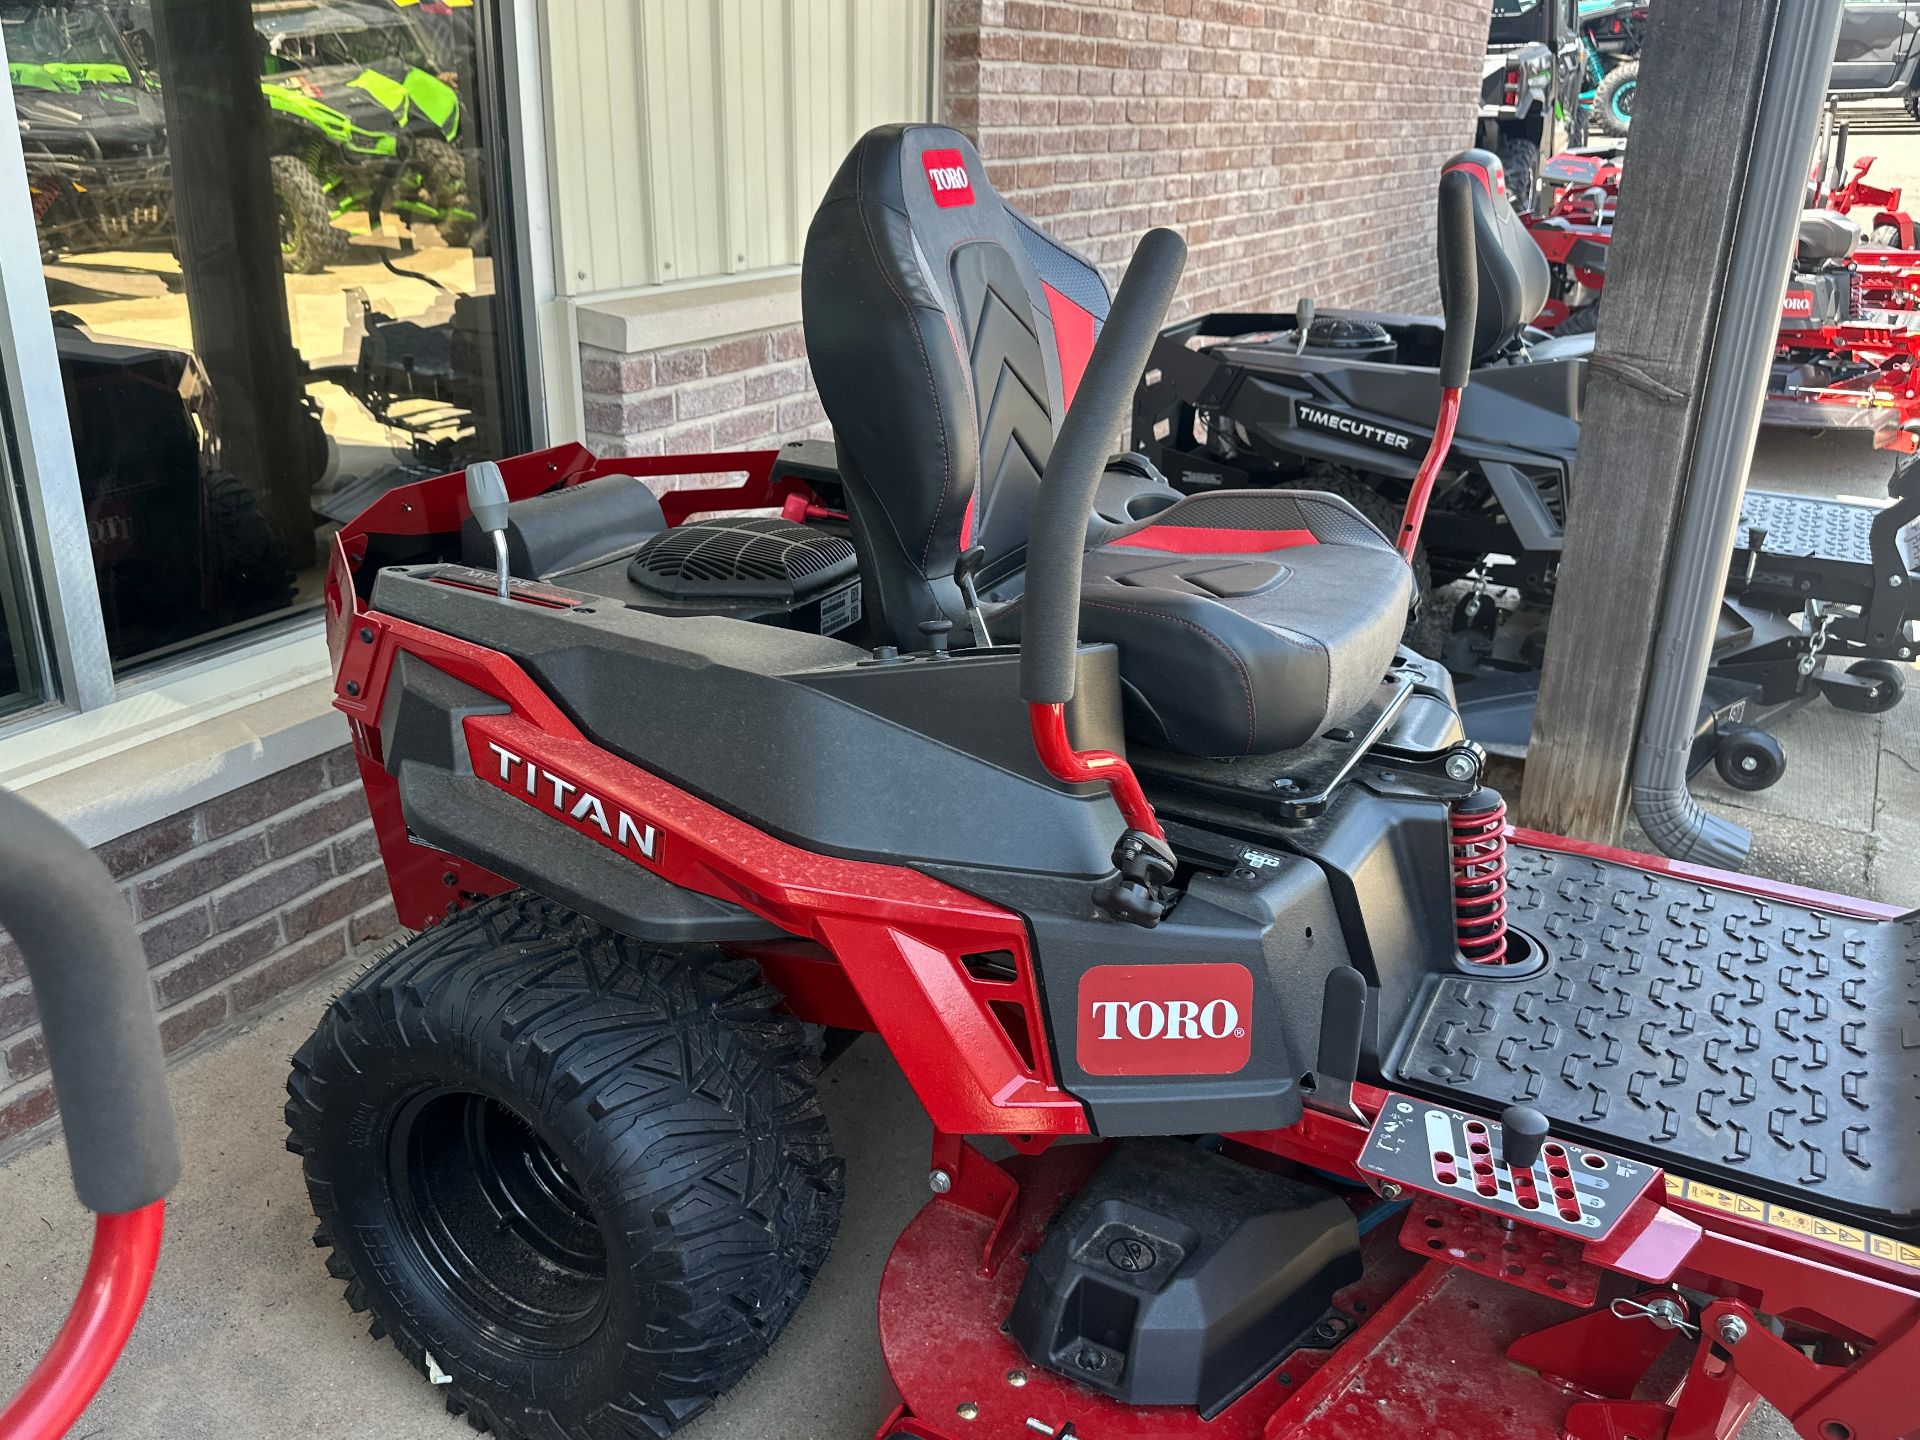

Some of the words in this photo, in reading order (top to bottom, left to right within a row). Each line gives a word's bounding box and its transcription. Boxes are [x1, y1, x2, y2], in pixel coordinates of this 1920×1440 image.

[929, 166, 969, 191] TORO
[1784, 298, 1810, 310] ORO
[1300, 406, 1409, 450] TIMECUTTER
[489, 741, 655, 859] TITAN
[1452, 1113, 1464, 1121] 2
[1569, 1146, 1582, 1154] 5
